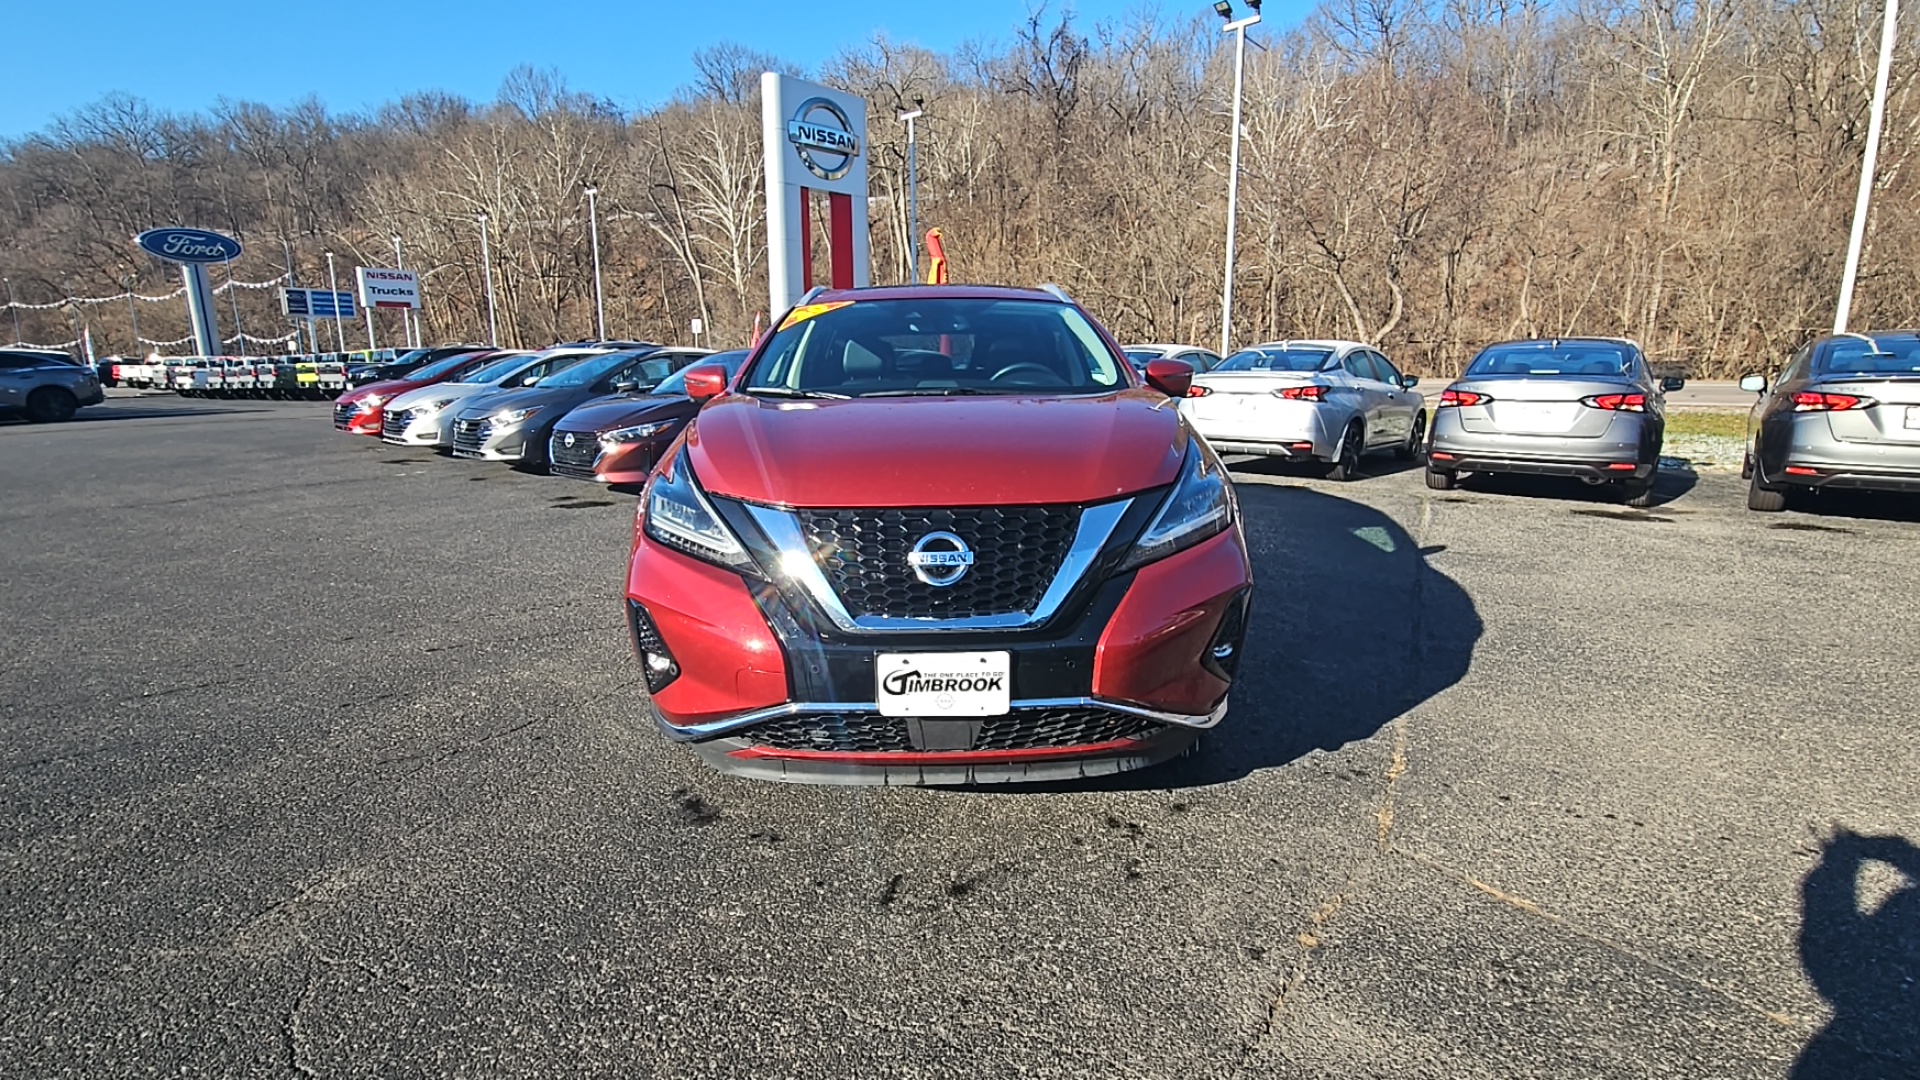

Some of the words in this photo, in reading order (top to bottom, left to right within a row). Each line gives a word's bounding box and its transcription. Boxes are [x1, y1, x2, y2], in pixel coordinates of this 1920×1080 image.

[798, 125, 856, 151] NISSAN
[163, 233, 222, 256] Ford
[366, 271, 413, 281] NISSAN
[369, 286, 414, 296] Trucks
[918, 554, 967, 563] NISSAN
